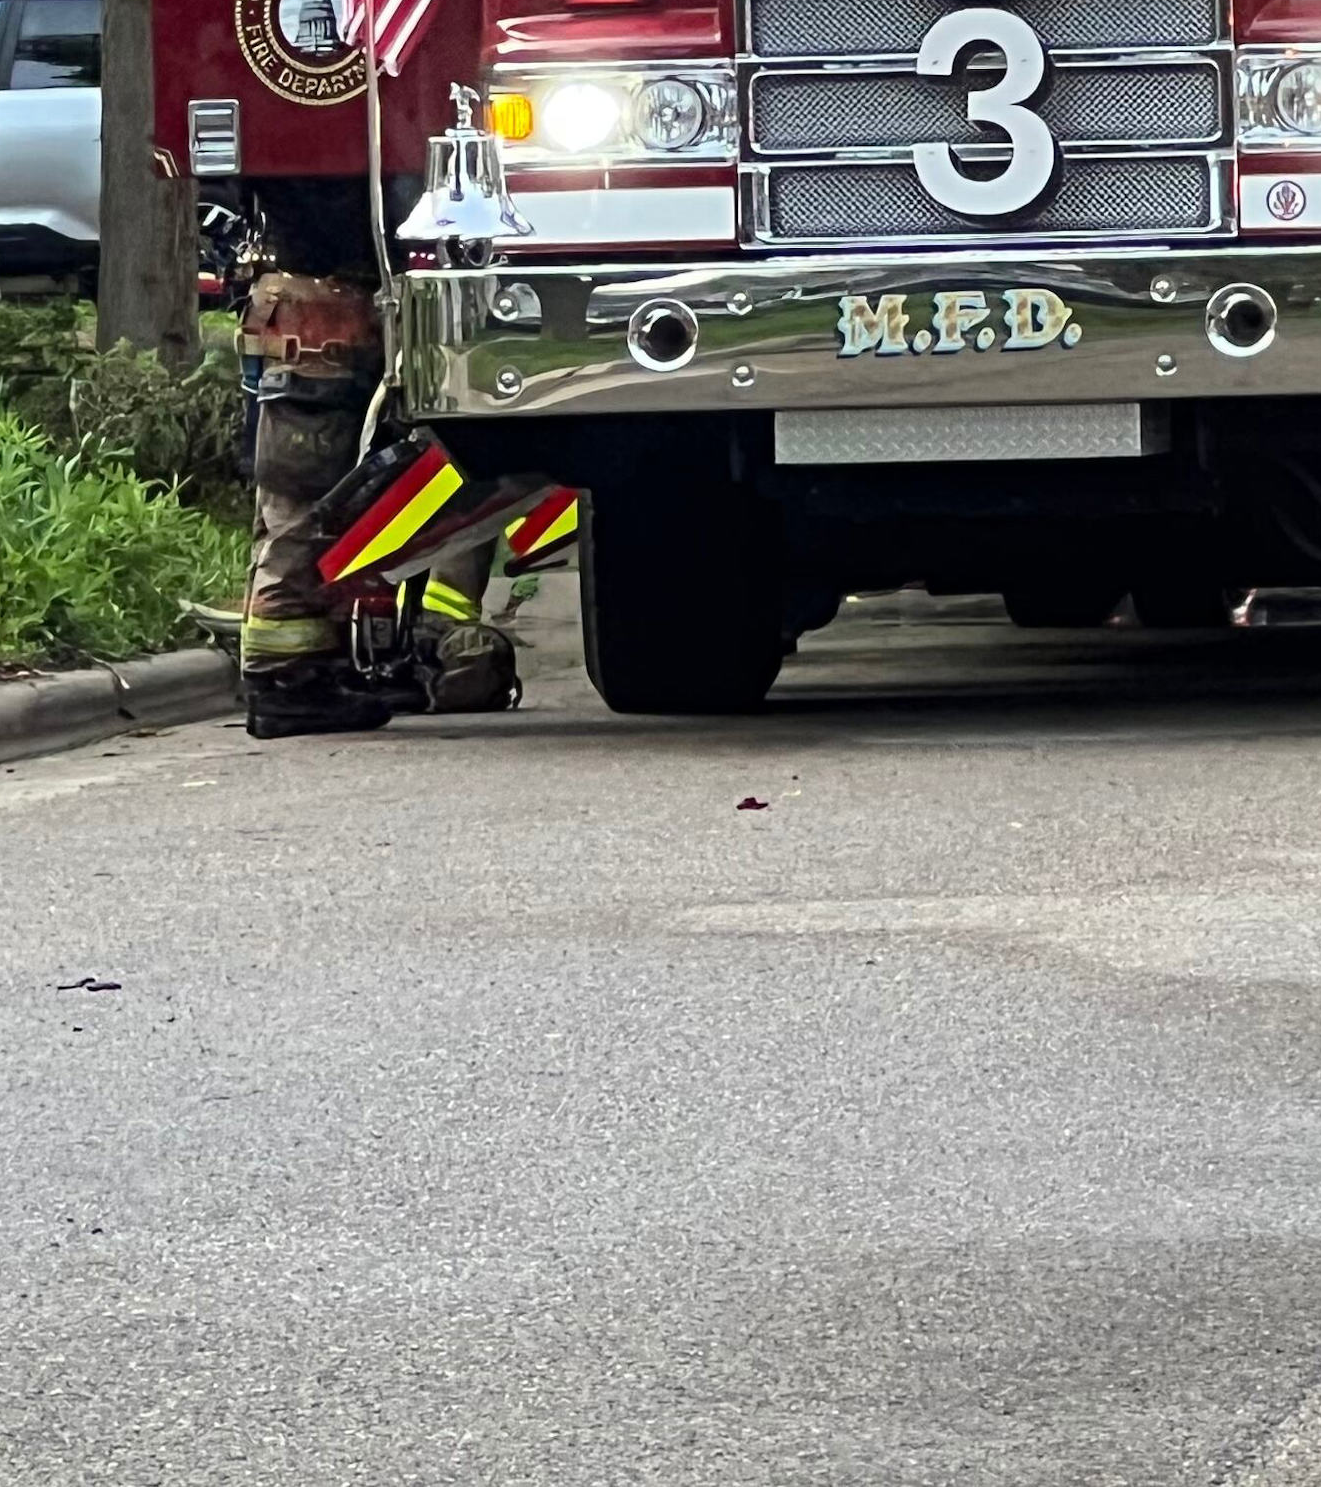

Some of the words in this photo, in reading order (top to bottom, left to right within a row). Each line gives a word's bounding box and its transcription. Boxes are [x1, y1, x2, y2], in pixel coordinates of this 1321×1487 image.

[246, 24, 277, 74] FIRE
[913, 7, 1055, 216] 3
[836, 288, 1083, 357] M.F.D.
